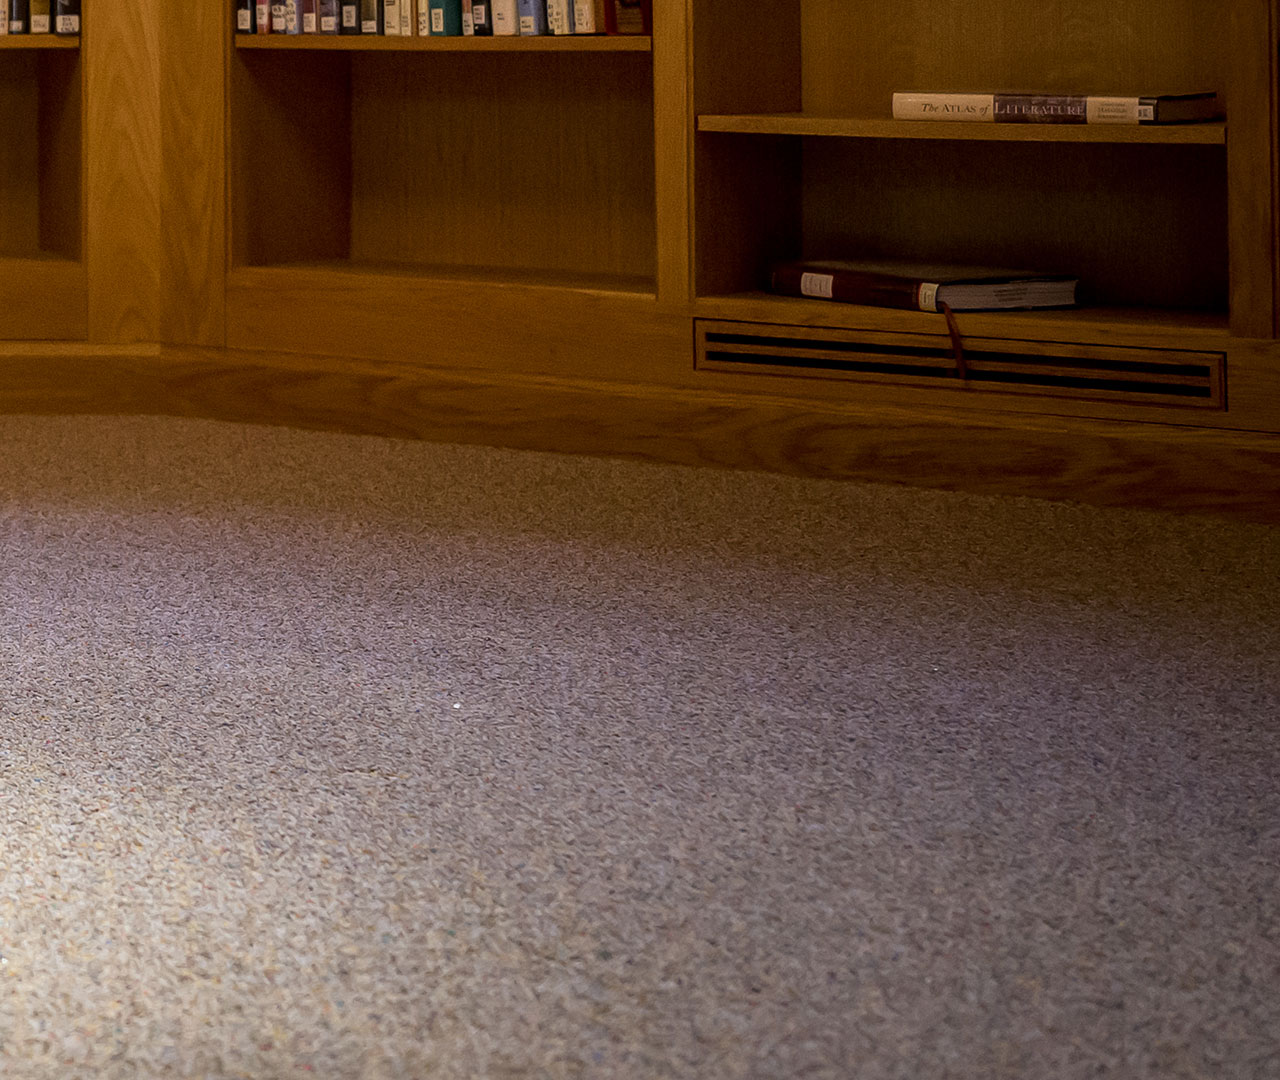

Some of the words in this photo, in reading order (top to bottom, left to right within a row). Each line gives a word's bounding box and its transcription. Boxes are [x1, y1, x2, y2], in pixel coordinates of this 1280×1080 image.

[921, 103, 938, 113] The
[942, 103, 976, 113] ATLAS
[979, 103, 991, 114] of
[995, 102, 1085, 116] LITERATURE
